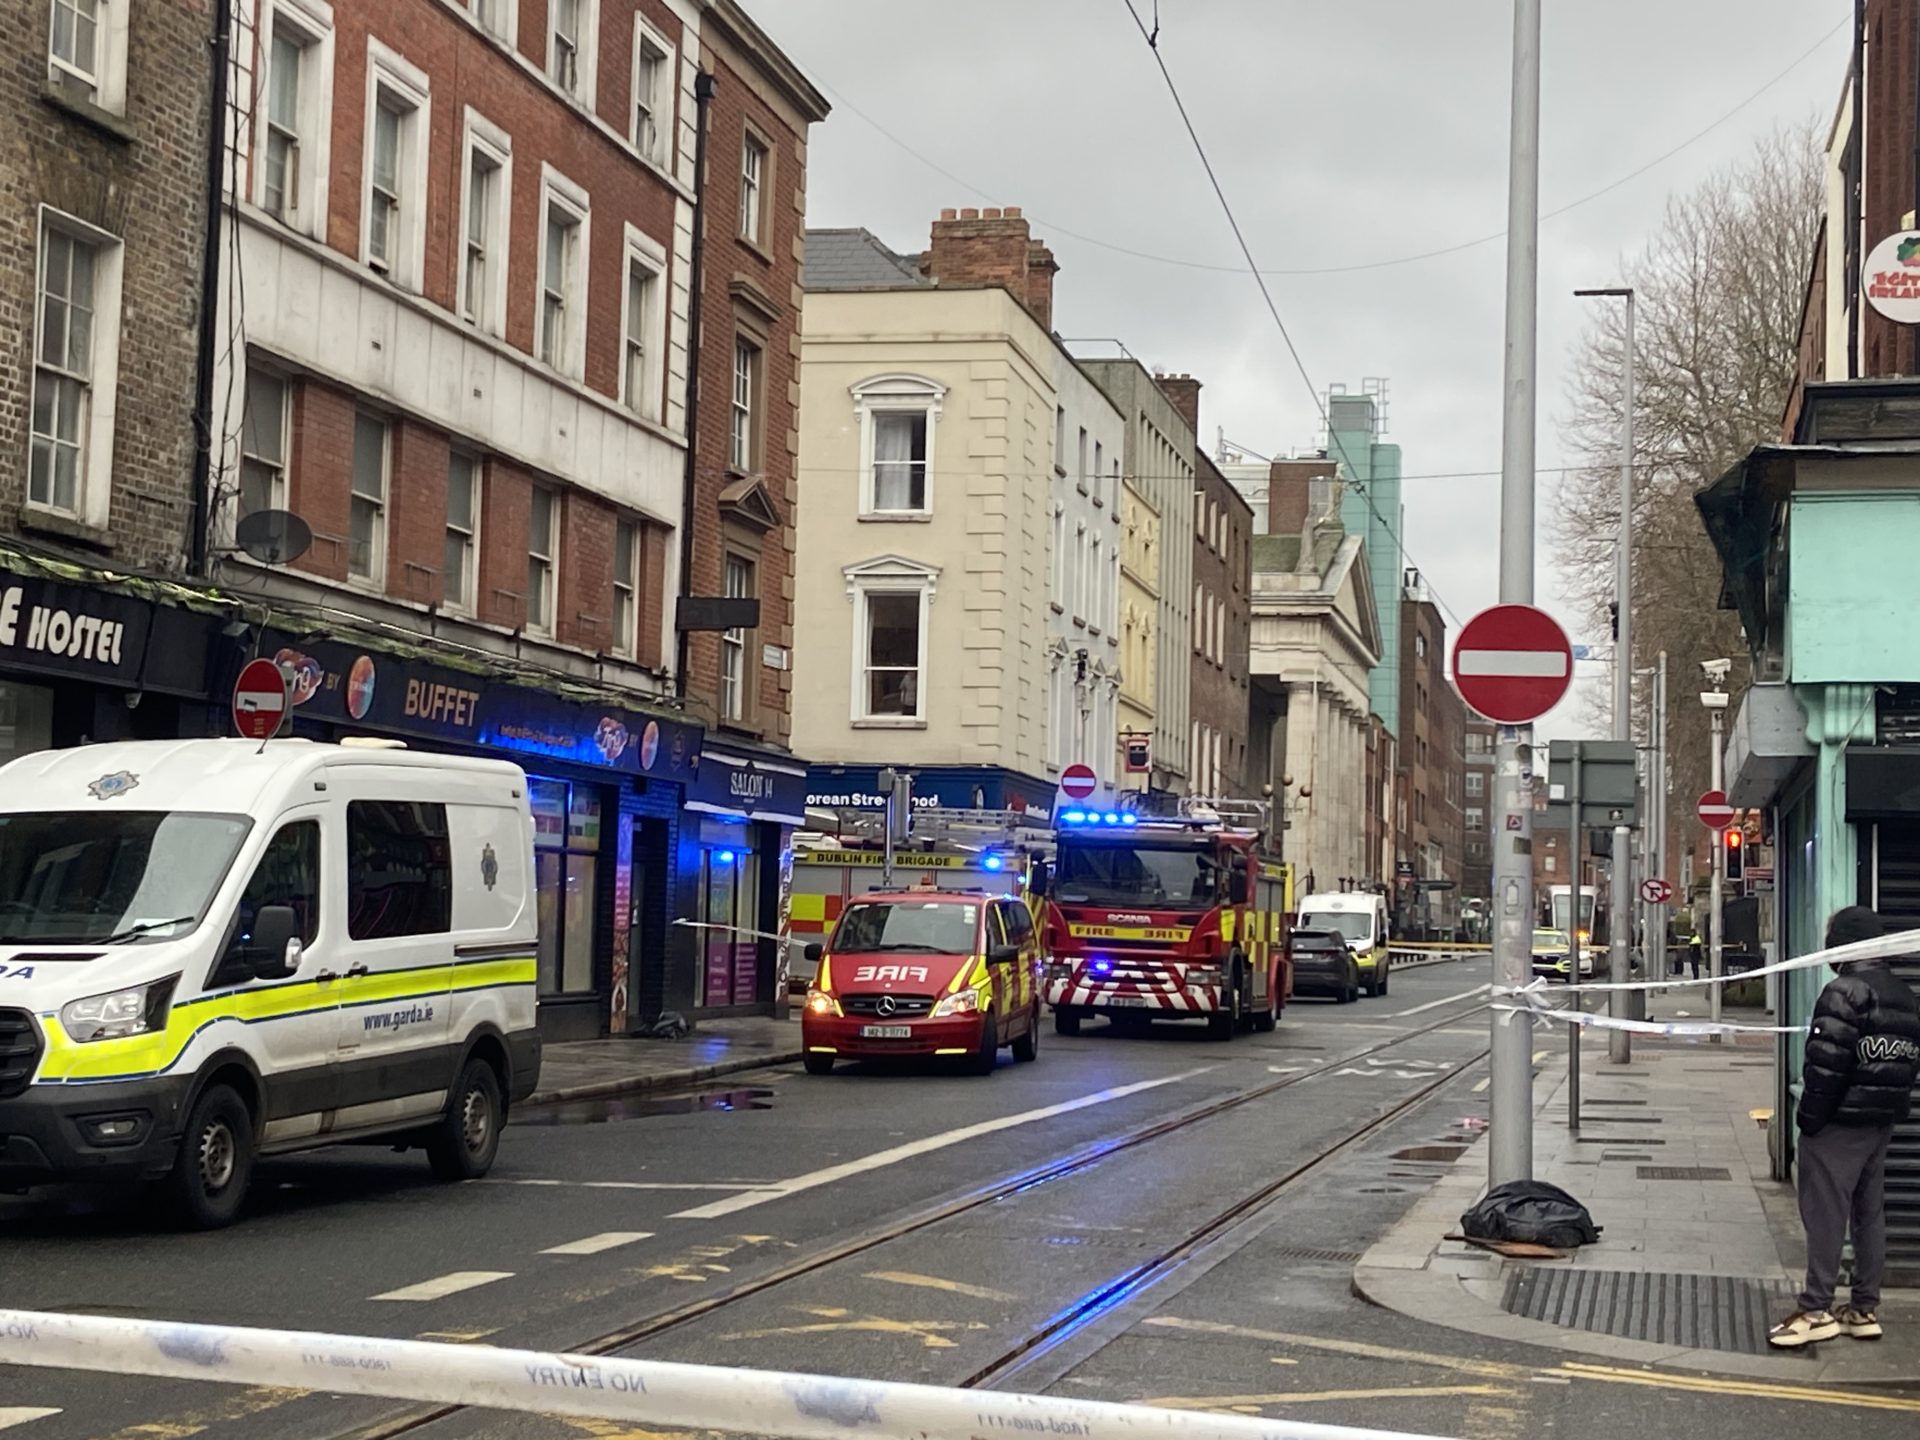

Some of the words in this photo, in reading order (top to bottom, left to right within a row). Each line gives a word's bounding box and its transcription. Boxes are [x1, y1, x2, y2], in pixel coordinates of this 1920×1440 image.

[27, 605, 124, 665] HOSTEL
[404, 679, 480, 728] BUFFET
[730, 772, 763, 797] SALON
[806, 794, 850, 806] orean
[852, 793, 885, 806] Stre
[817, 853, 862, 864] DUBLIN
[865, 855, 885, 864] FIR
[896, 856, 951, 867] BRIGADE
[1107, 913, 1152, 924] SCANIA
[1075, 926, 1115, 937] FIRE
[363, 1002, 434, 1032] www.garda.ie
